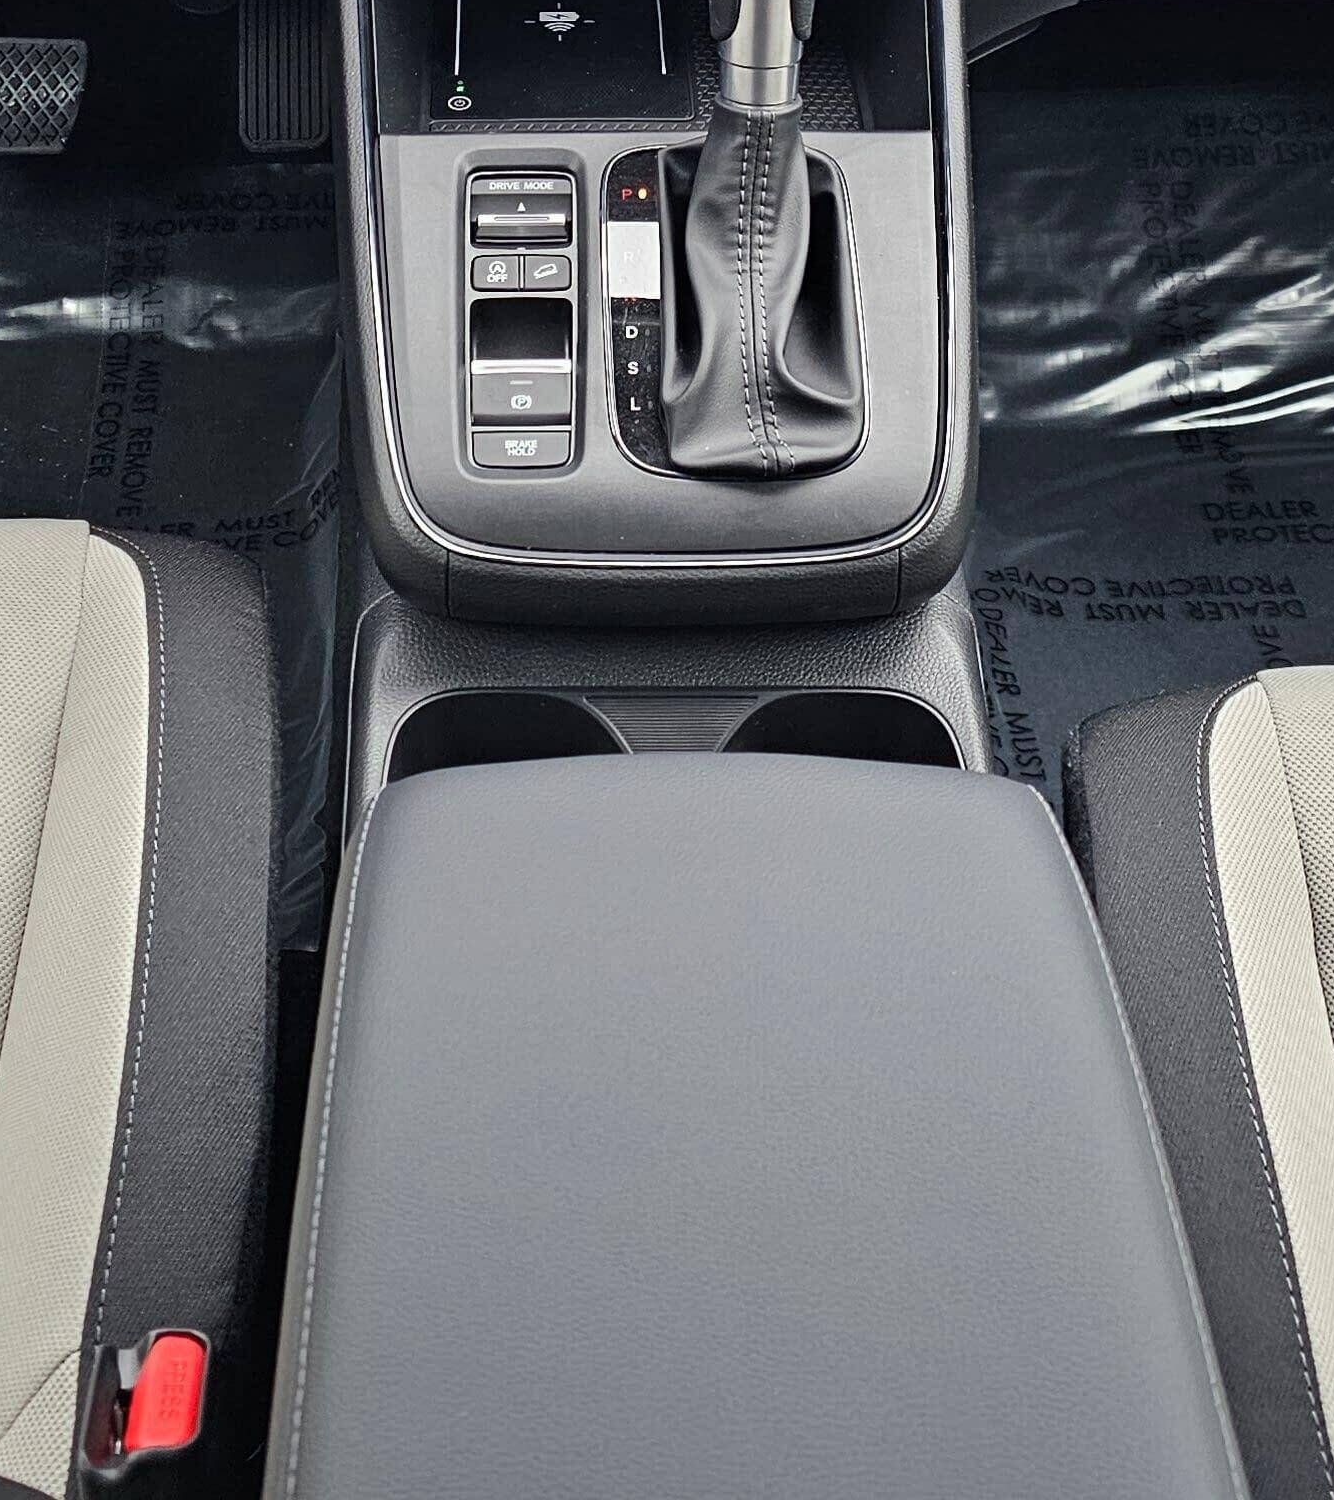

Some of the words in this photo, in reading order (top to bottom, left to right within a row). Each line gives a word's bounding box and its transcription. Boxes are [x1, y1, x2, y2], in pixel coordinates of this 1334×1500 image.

[489, 181, 520, 190] DRIVE
[523, 181, 554, 190] MODE
[622, 189, 633, 200] P
[487, 274, 508, 283] OFF
[625, 327, 639, 338] D
[627, 362, 639, 374] S
[133, 359, 164, 414] MUST
[629, 399, 641, 411] L
[86, 400, 123, 480] COVER
[505, 440, 538, 449] BRAKE
[507, 448, 536, 457] HOLD
[115, 426, 154, 518] REMOVE
[216, 508, 296, 533] MUST
[1200, 500, 1320, 523] DEALER
[983, 566, 1097, 596] COVER
[1104, 575, 1297, 598] PROTECTIVE
[1085, 602, 1166, 622] MUST
[1185, 600, 1307, 620] DEALER
[977, 607, 1022, 696] DEALER
[1002, 710, 1047, 782] MUST
